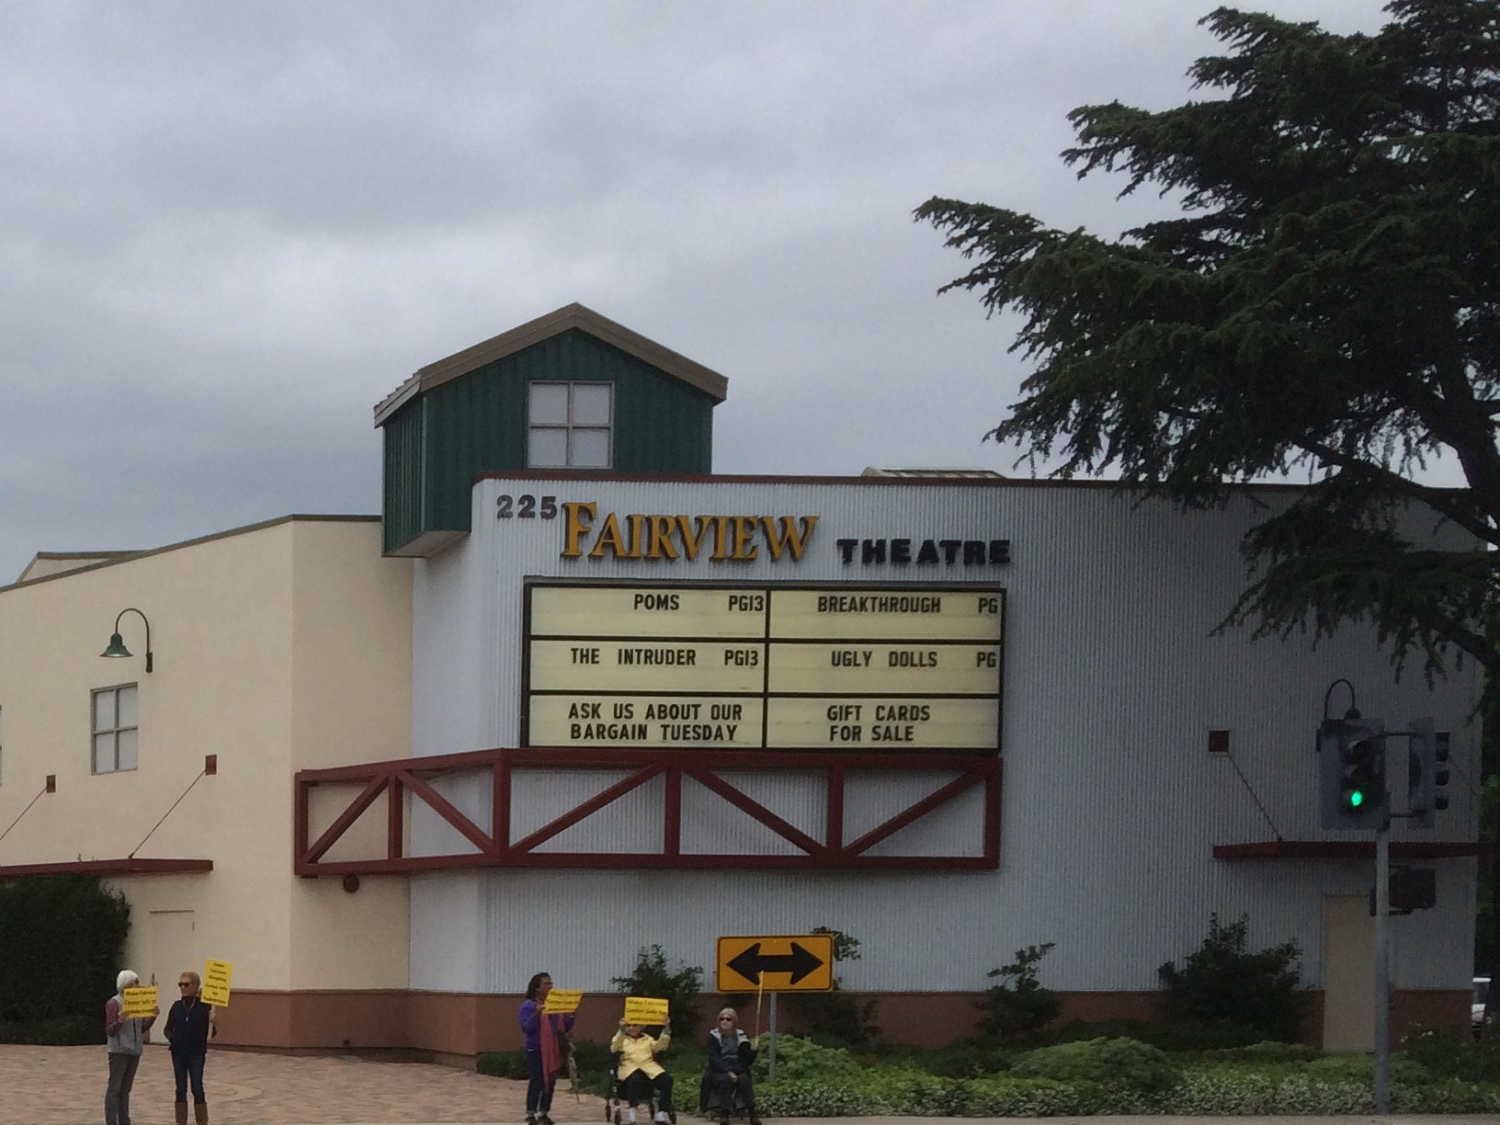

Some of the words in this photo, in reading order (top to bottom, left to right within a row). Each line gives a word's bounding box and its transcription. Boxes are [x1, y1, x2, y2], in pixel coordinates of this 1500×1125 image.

[496, 494, 558, 520] 225
[560, 501, 820, 563] FAIRVIEW
[836, 538, 1011, 566] THEATRE
[633, 593, 680, 611] POMS
[728, 594, 764, 612] PG13
[817, 595, 941, 614] BREAKTHROUGH
[978, 597, 998, 614] PG
[570, 647, 600, 665] THE
[617, 648, 697, 666] INTRUDER
[724, 649, 759, 667] PG13
[831, 650, 873, 667] UGLY
[888, 650, 938, 668] DOLLS
[976, 651, 997, 668] PG
[568, 702, 602, 720] ASK
[613, 703, 634, 720] US
[645, 703, 702, 721] ABOUT
[710, 704, 743, 721] OUR
[827, 705, 863, 722] GIFT
[875, 705, 931, 722] CARDS
[570, 723, 648, 740] BARGAIN
[660, 724, 738, 741] TUESDAY
[829, 725, 862, 742] FOR
[871, 725, 914, 742] SALE
